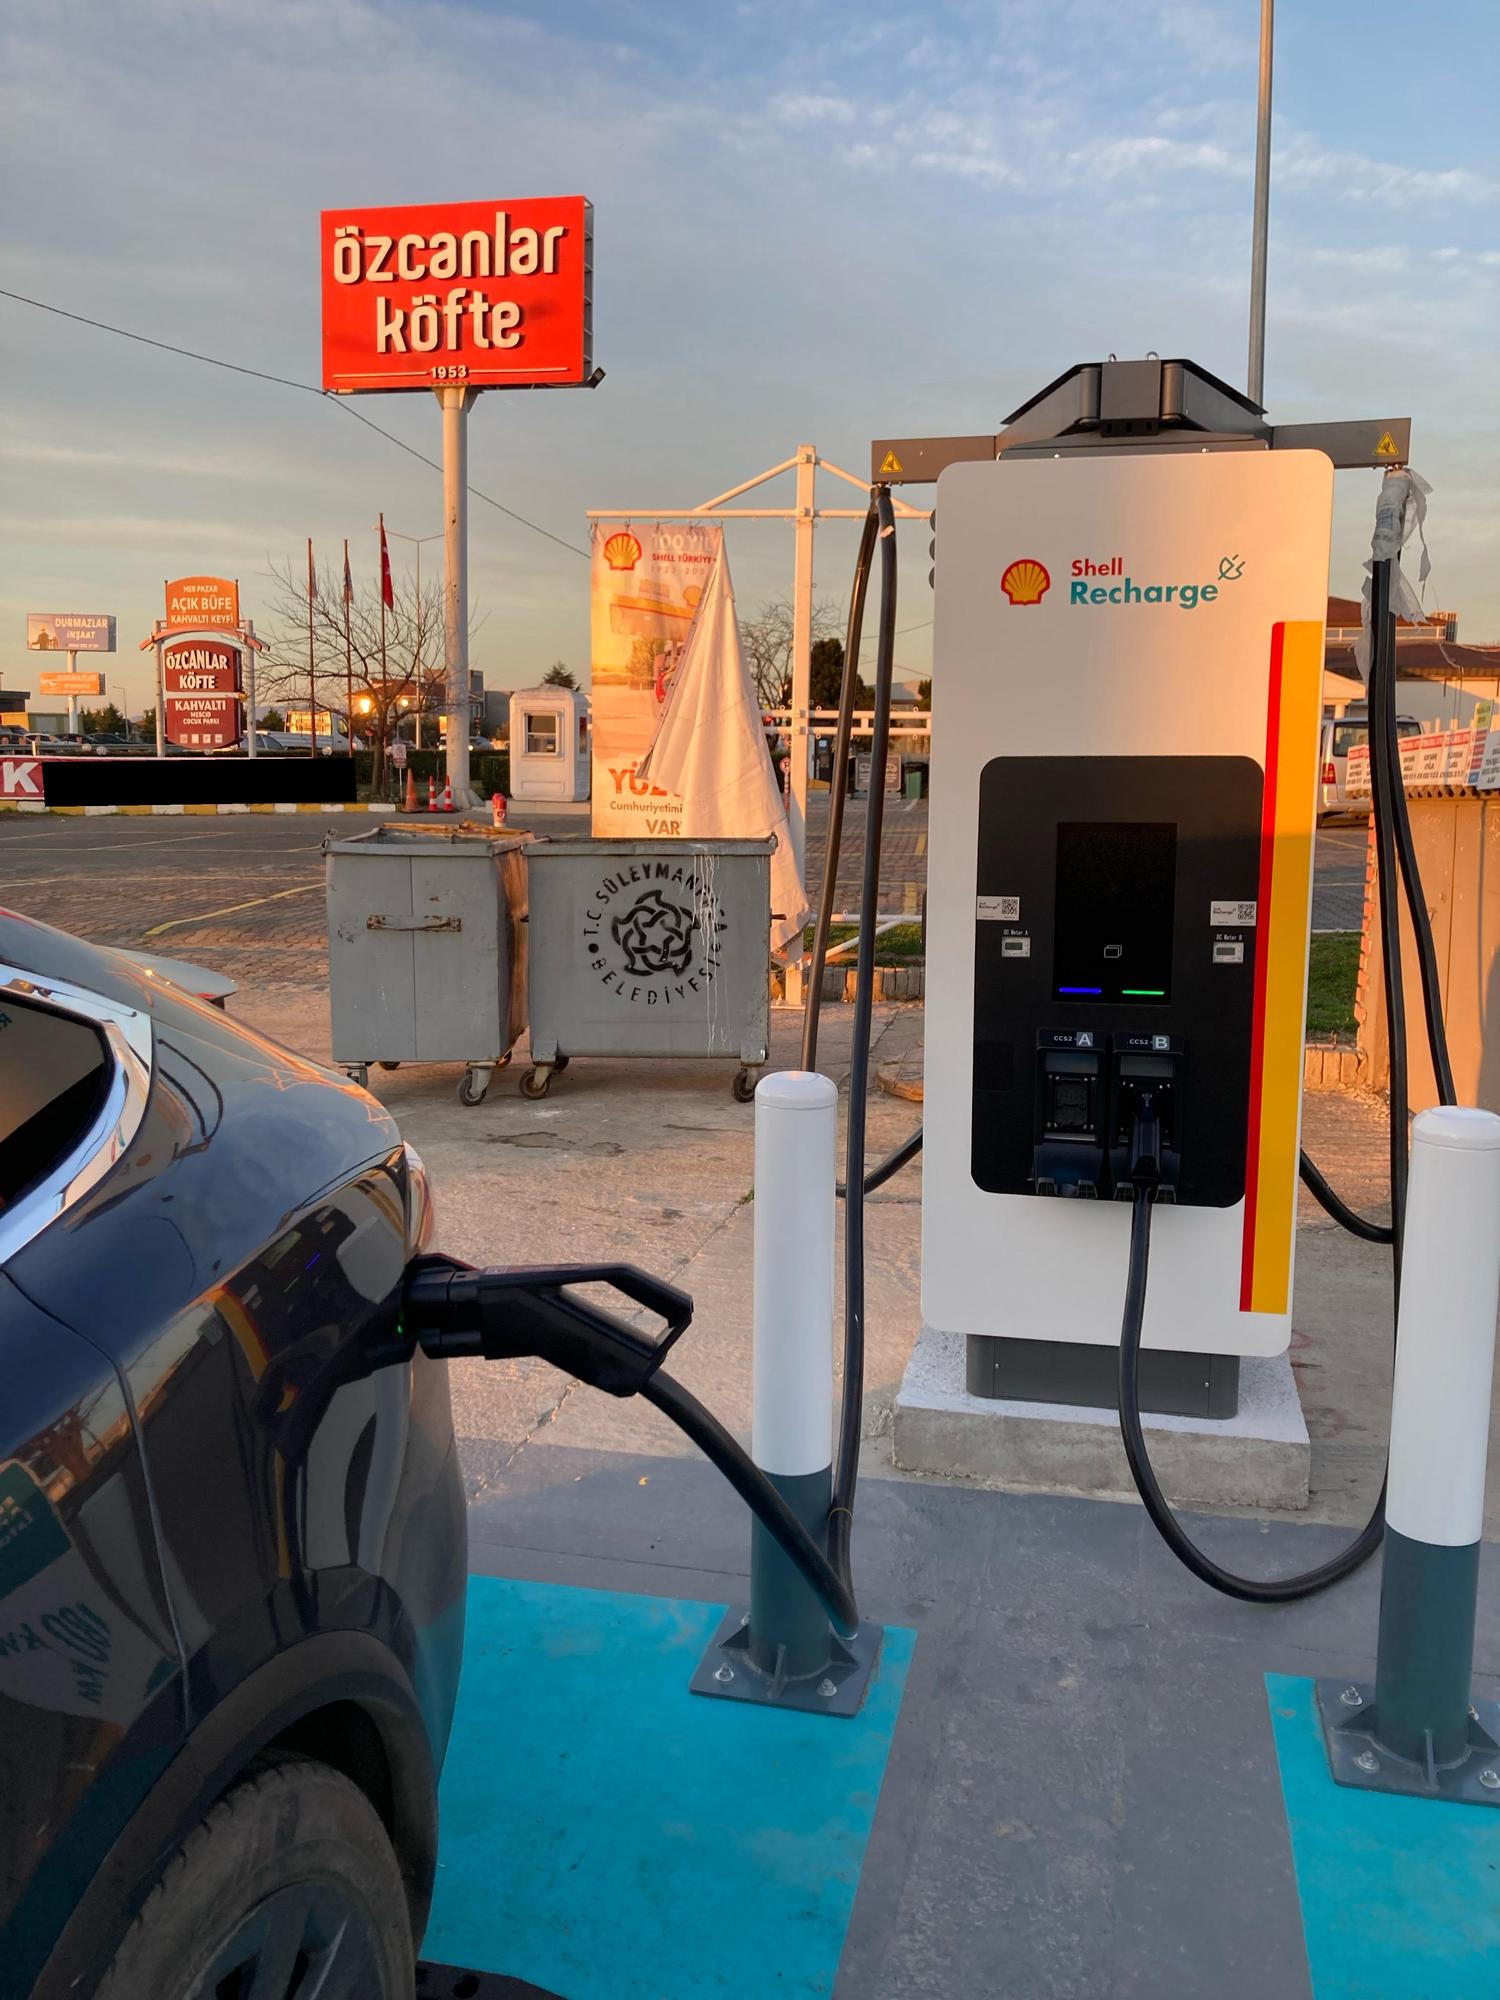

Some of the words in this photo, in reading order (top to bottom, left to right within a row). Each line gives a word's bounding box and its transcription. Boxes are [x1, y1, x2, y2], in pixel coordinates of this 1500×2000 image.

[333, 211, 565, 284] özcanlar
[376, 287, 522, 353] köfte
[430, 365, 468, 379] 1953
[652, 553, 676, 562] SHELL
[1071, 557, 1123, 577] Shell
[1070, 577, 1219, 610] Recharge
[171, 597, 199, 613] AÇIK
[201, 594, 232, 610] BÜFE
[55, 618, 108, 628] DURMAZLAR
[171, 614, 209, 624] KAHVALTI
[166, 649, 227, 670] ÖZCANLAR
[179, 671, 216, 689] KÖFTE
[175, 700, 226, 711] KAHVALTI
[1078, 1033, 1092, 1046] A
[1155, 1036, 1169, 1049] B
